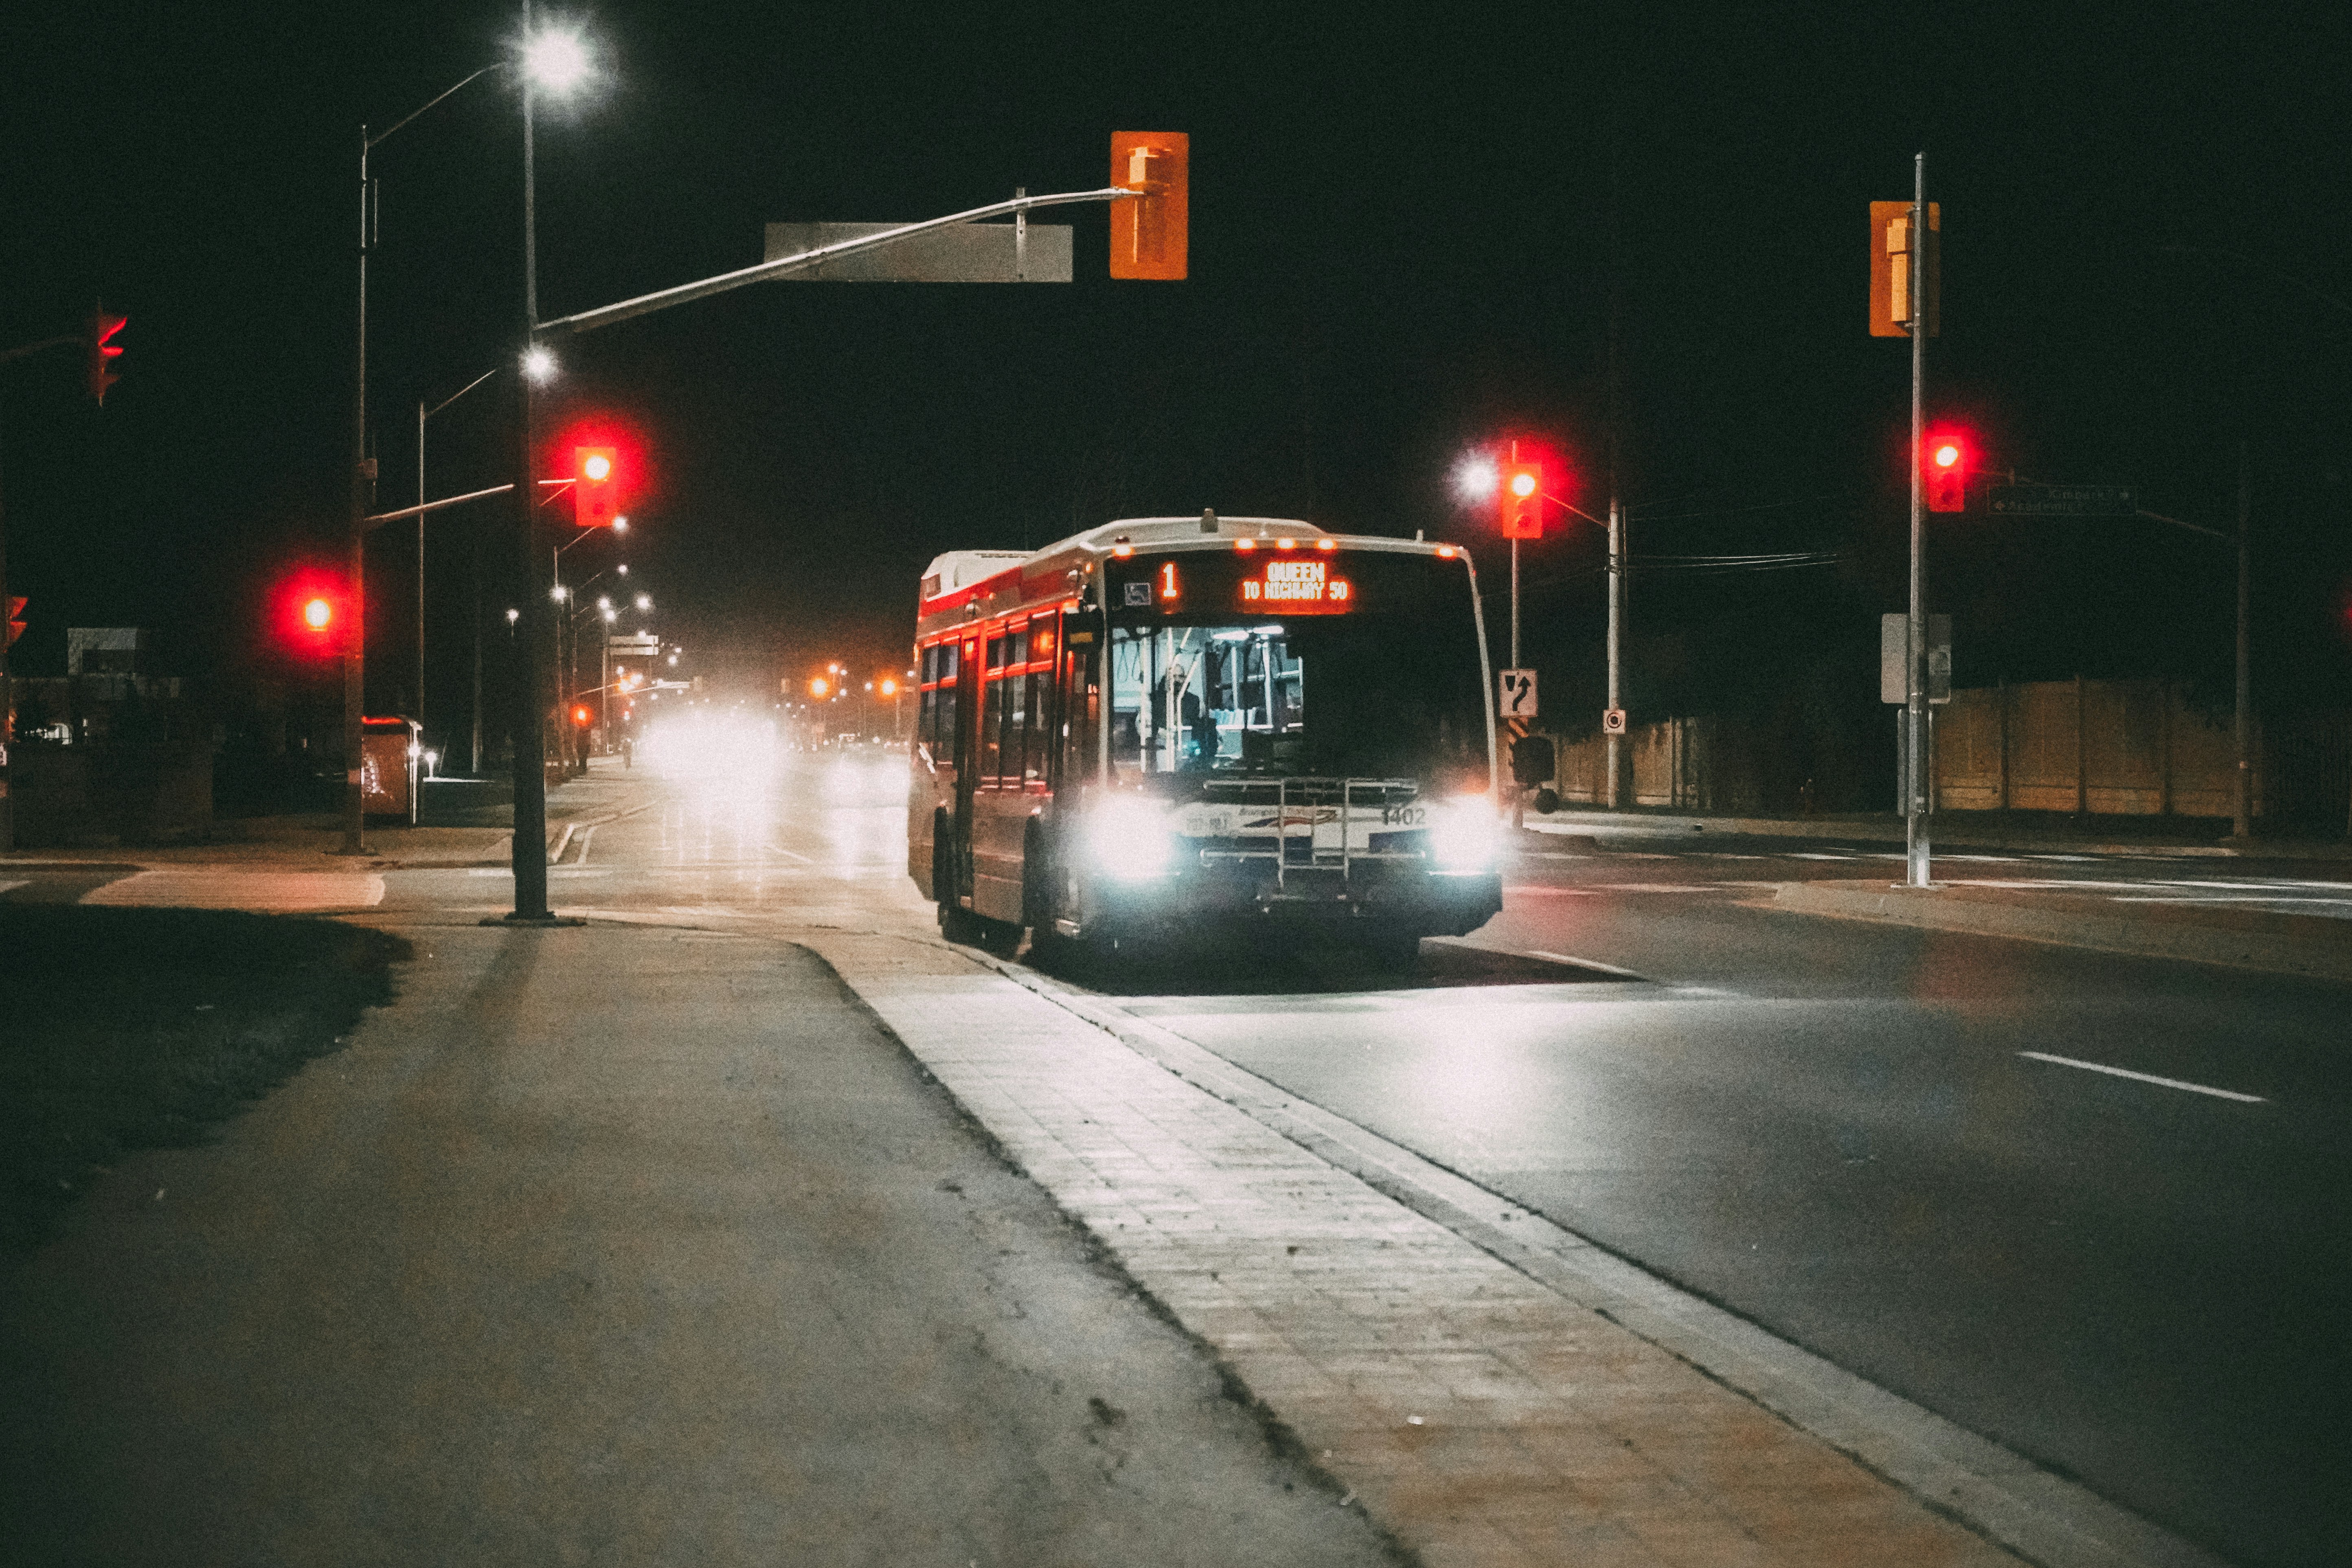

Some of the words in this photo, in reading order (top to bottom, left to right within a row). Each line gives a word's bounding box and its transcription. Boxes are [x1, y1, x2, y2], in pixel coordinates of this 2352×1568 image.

[1163, 564, 1177, 597] 1
[1267, 562, 1325, 582] QUEEN
[1243, 581, 1260, 599] TO
[1264, 581, 1325, 599] HIGHWAY
[1329, 581, 1347, 599] 50
[1382, 807, 1426, 825] 1402
